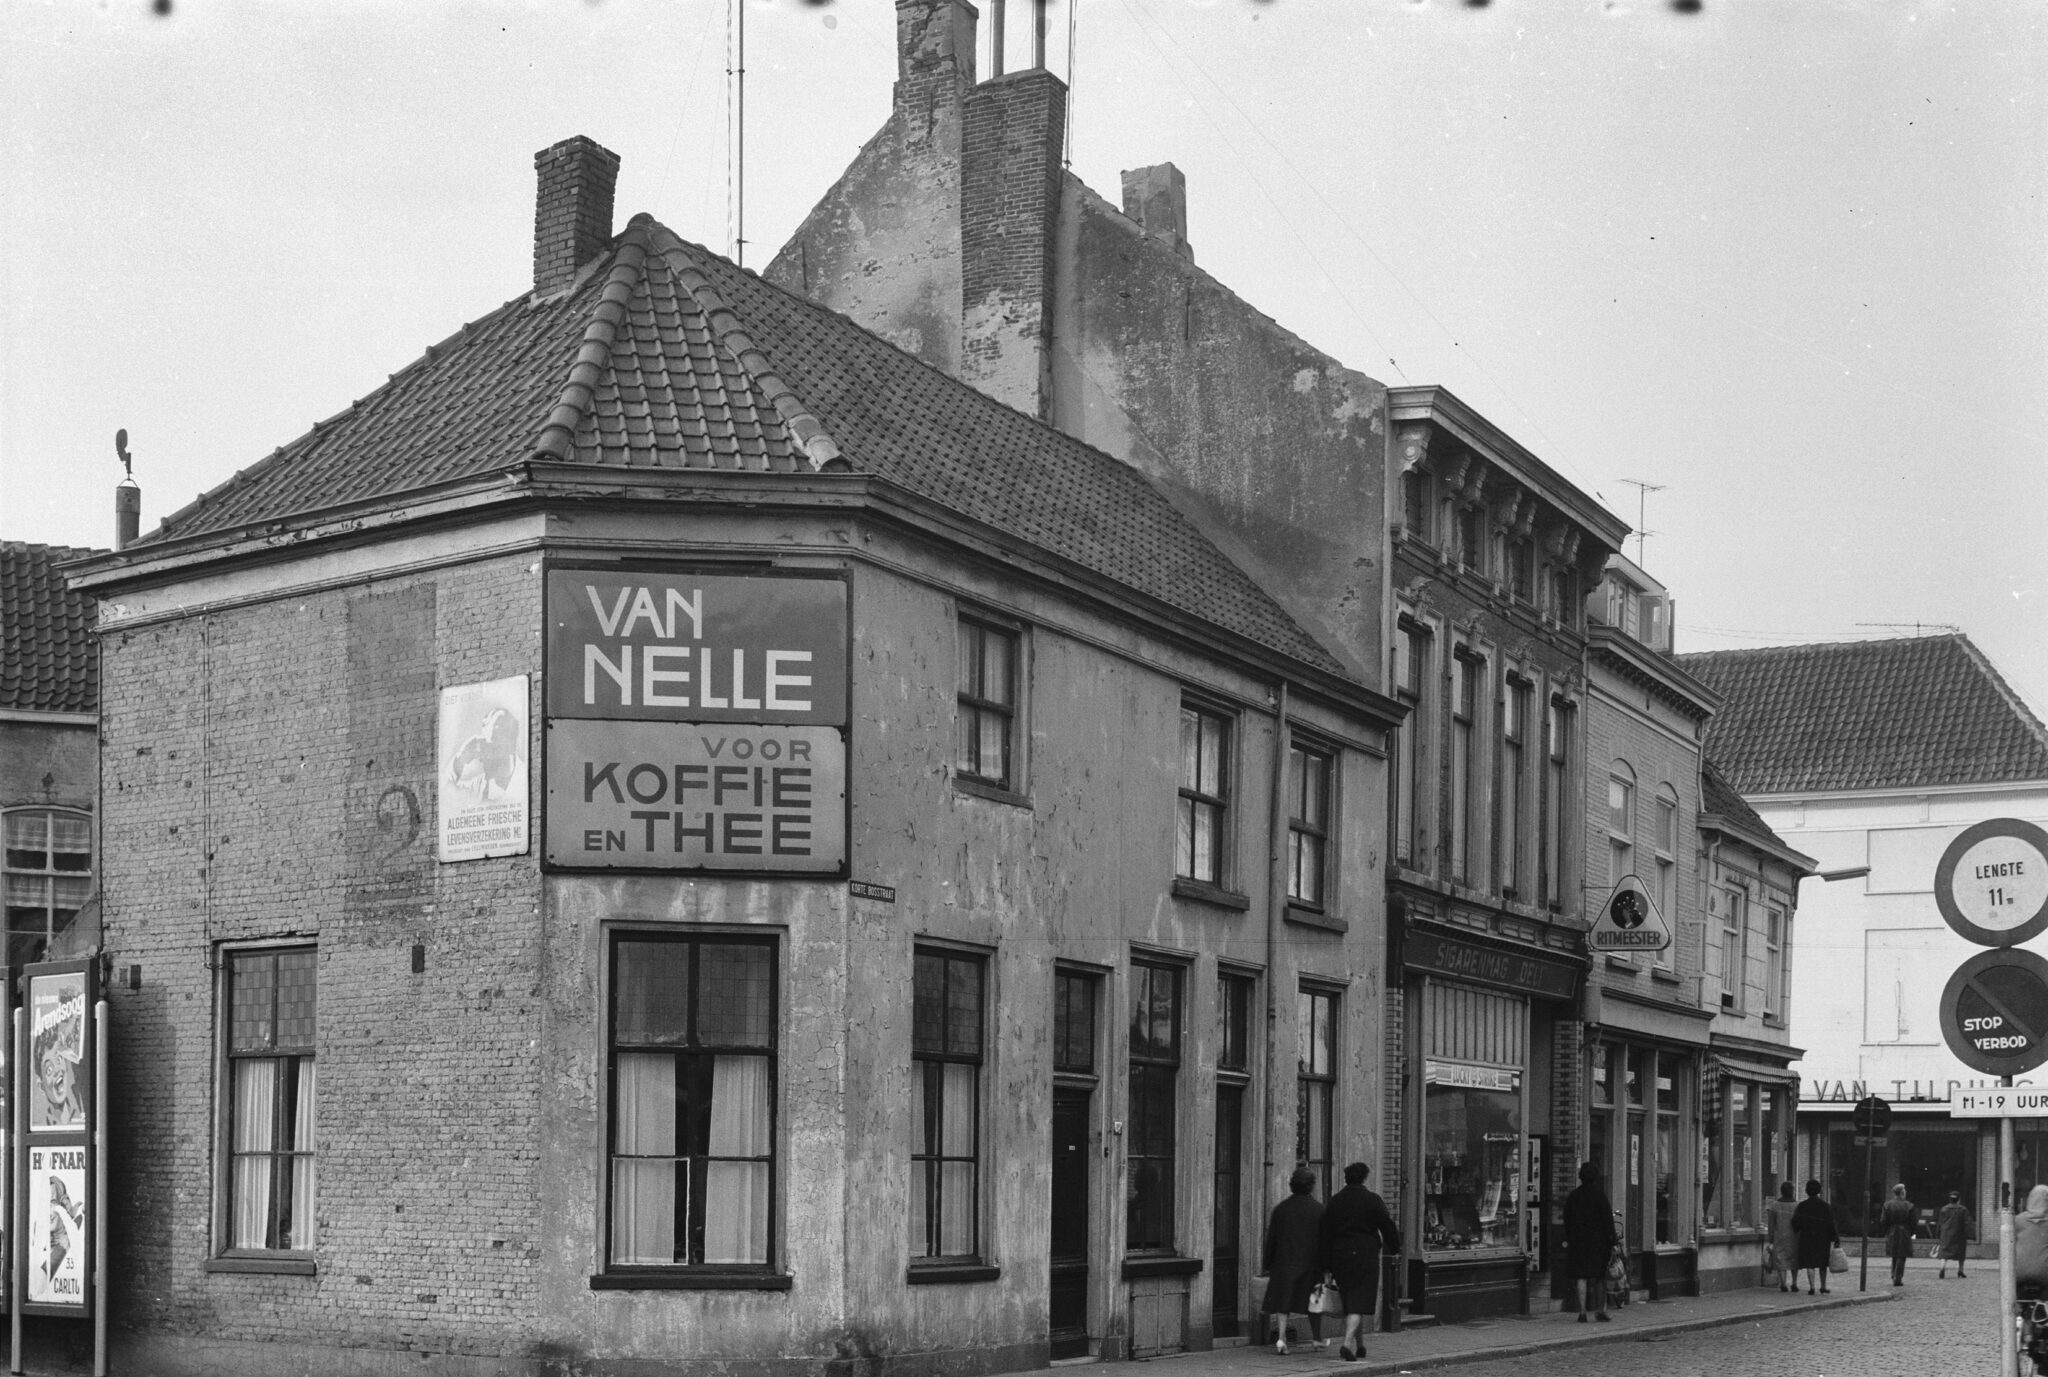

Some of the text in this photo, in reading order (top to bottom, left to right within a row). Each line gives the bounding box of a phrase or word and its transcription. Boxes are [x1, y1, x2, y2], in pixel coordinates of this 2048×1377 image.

[585, 585, 702, 639] VAN
[585, 644, 812, 711] NELLE
[701, 737, 812, 762] VOOR
[584, 762, 812, 808] KOFFIE
[448, 814, 485, 830] ALGEMEENE
[488, 810, 522, 825] FRIESCHE
[448, 827, 511, 846] LEVENSVERZEKERING
[584, 811, 811, 855] EN THEE
[1976, 862, 2024, 879] LENGTE
[851, 883, 867, 895] KORTE
[1597, 930, 1661, 945] RITMEESTER
[1964, 1016, 2003, 1031] STOP
[1974, 1036, 2027, 1050] VERBOD
[1453, 1066, 1470, 1084] LUCKY
[1813, 1080, 1867, 1100] VAN
[2016, 1095, 2048, 1109] UUR
[32, 1152, 86, 1170] HFNAR
